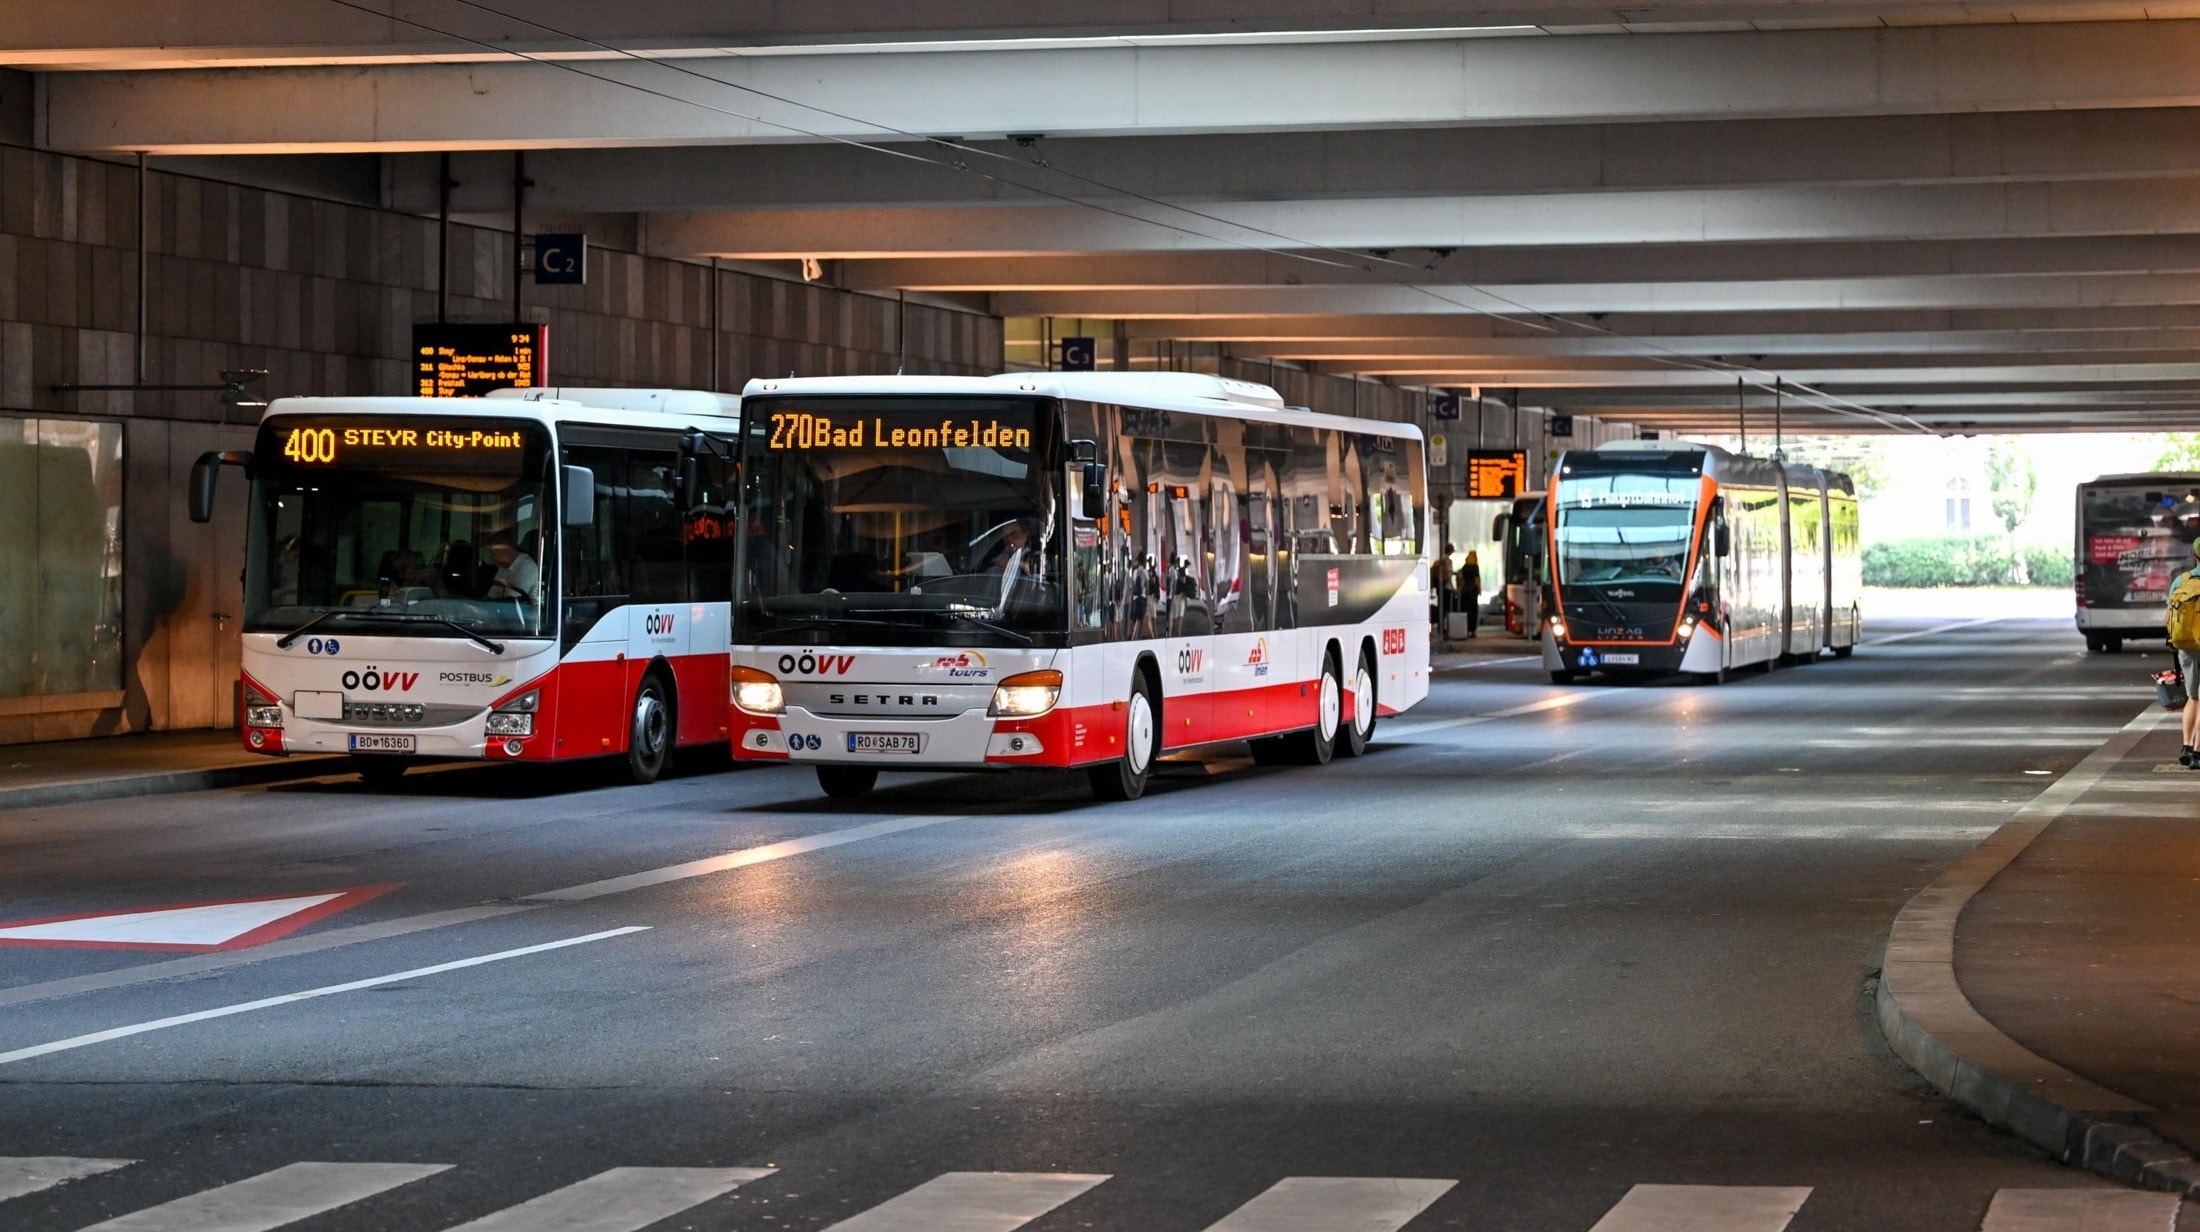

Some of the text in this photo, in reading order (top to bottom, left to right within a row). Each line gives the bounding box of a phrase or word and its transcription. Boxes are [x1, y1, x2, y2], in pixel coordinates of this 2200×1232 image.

[420, 363, 434, 371] 311
[770, 413, 1030, 448] 270 Bad Leonfelden
[284, 428, 521, 462] 400 STEYR City-Point
[646, 608, 675, 635] OÖVV
[778, 649, 856, 675] OÖVV
[1178, 643, 1203, 674] OÖVV
[342, 665, 420, 691] OÖVV
[439, 672, 493, 682] POSTBUS
[949, 668, 988, 677] tours
[830, 694, 938, 705] SETRA
[381, 737, 409, 748] 16360
